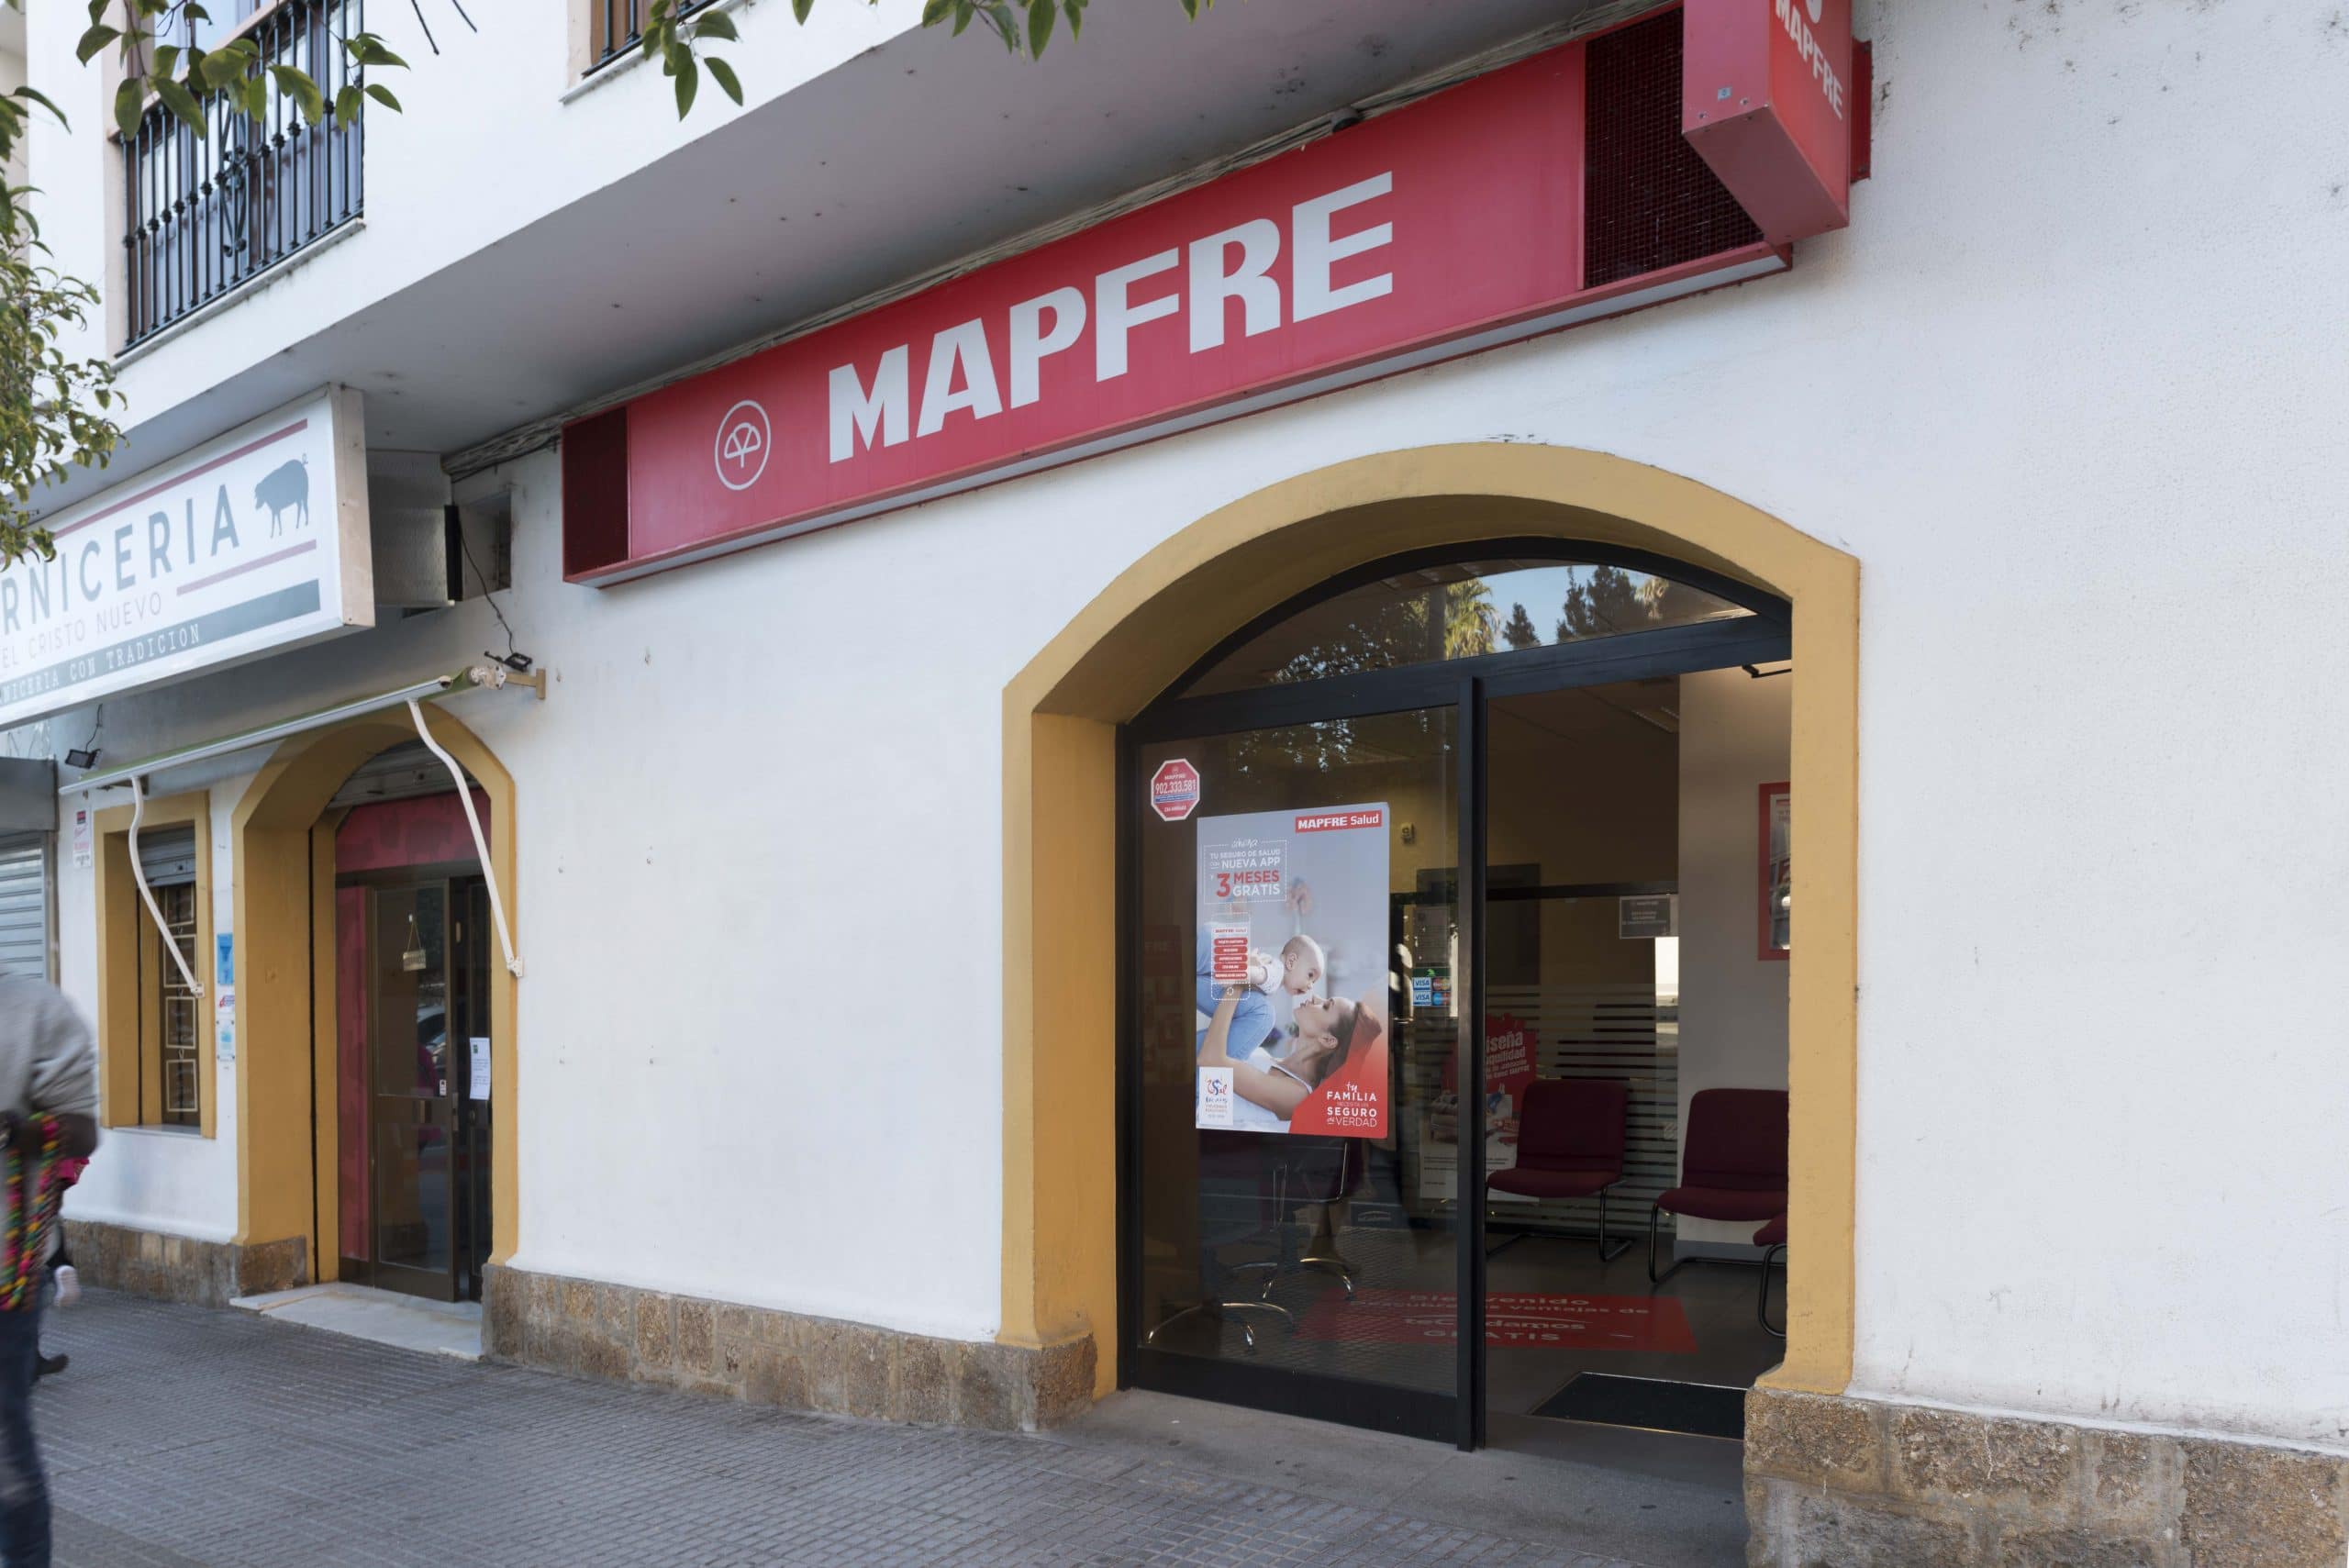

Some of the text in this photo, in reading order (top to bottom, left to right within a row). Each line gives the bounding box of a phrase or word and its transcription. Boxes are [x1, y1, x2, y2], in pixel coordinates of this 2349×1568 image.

[1776, 0, 1843, 120] MAPFRE
[829, 171, 1393, 463] MAPFRE
[29, 618, 86, 659] CRISTO
[96, 592, 161, 633] NUEVO
[0, 623, 200, 705] NICERIA CON TRADICION
[1297, 814, 1379, 829] MAPFRE Salud
[1221, 858, 1257, 869] NUEVA
[1260, 856, 1281, 867] APP
[1216, 873, 1230, 897] 3
[1233, 870, 1280, 884] MESES
[1232, 884, 1281, 896] GRATIS
[1486, 1031, 1523, 1053] iseña
[1327, 1091, 1377, 1102] FAMILIA
[1327, 1106, 1377, 1118] SEGURO
[1336, 1116, 1377, 1127] VERDAD
[1424, 1329, 1561, 1341] GATIS
